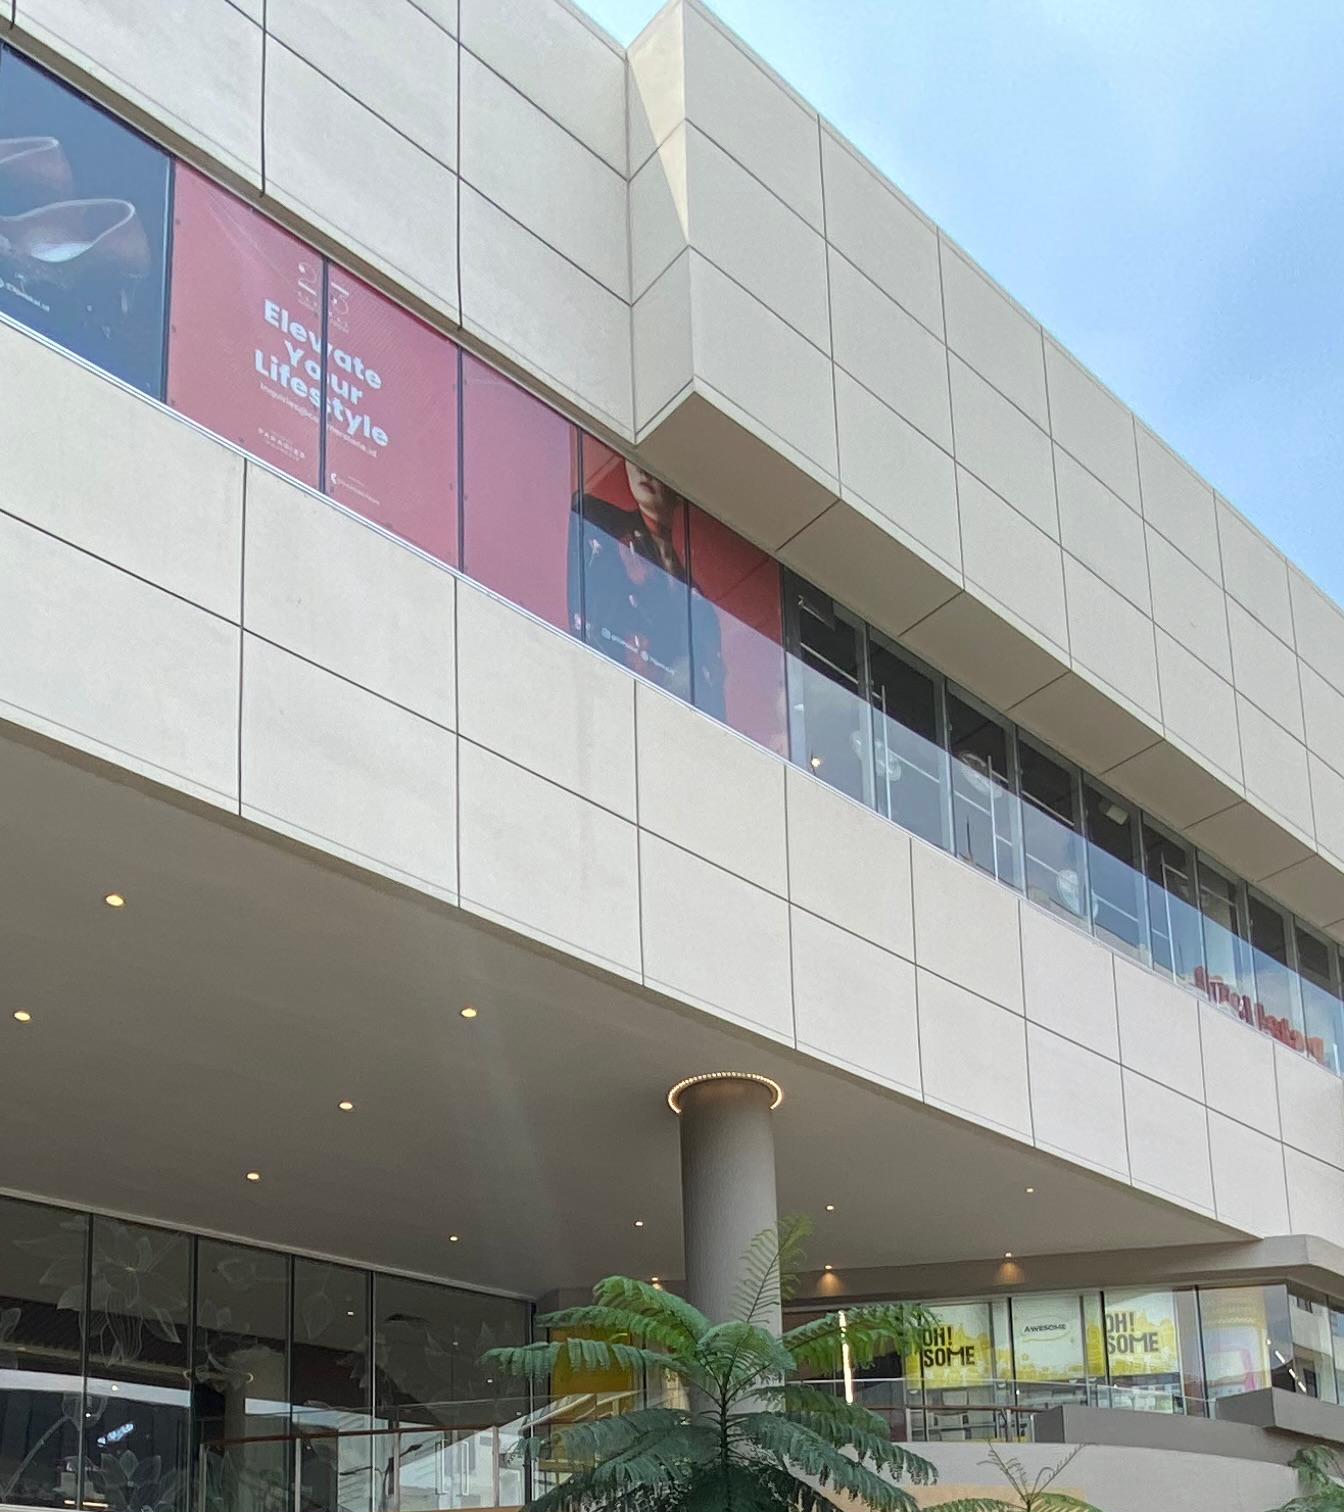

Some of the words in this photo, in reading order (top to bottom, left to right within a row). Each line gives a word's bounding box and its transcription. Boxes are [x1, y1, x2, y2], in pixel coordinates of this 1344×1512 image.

[264, 299, 382, 389] Elevate
[284, 340, 363, 405] Your
[255, 349, 389, 447] Lifestyle
[1023, 1322, 1067, 1333] AWESOME
[1106, 1312, 1134, 1332] OH!
[922, 1326, 952, 1347] OH!
[1107, 1332, 1159, 1354] SOME
[923, 1345, 975, 1368] SOME
